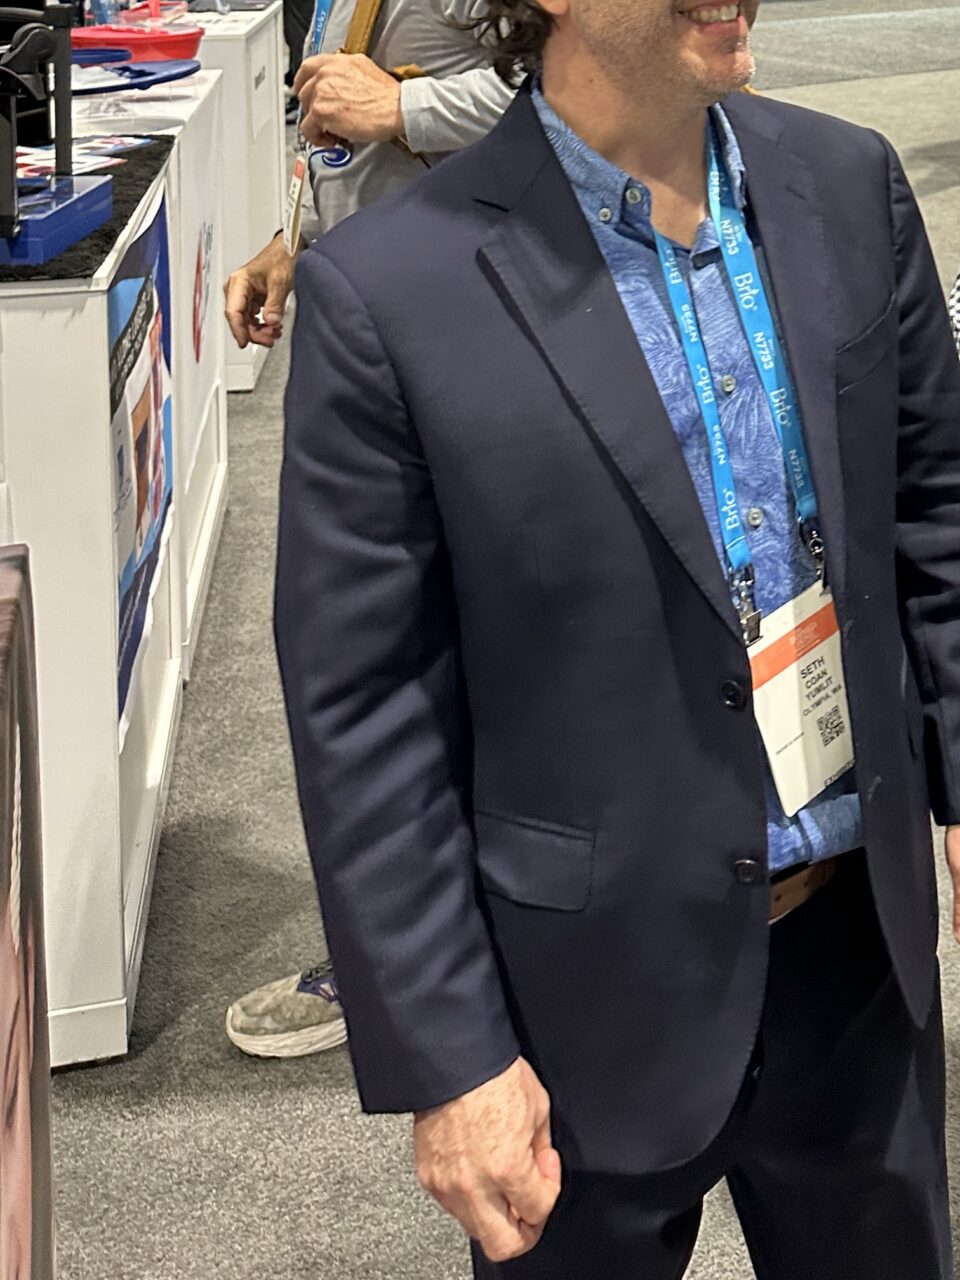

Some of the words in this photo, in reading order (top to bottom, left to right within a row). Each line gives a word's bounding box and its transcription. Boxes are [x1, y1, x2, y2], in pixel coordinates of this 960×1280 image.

[734, 272, 760, 309] Brio
[753, 331, 774, 370] N7733
[697, 365, 713, 404] Brio
[770, 387, 790, 425] Brio
[721, 490, 739, 530] Brio
[800, 656, 825, 679] SETH
